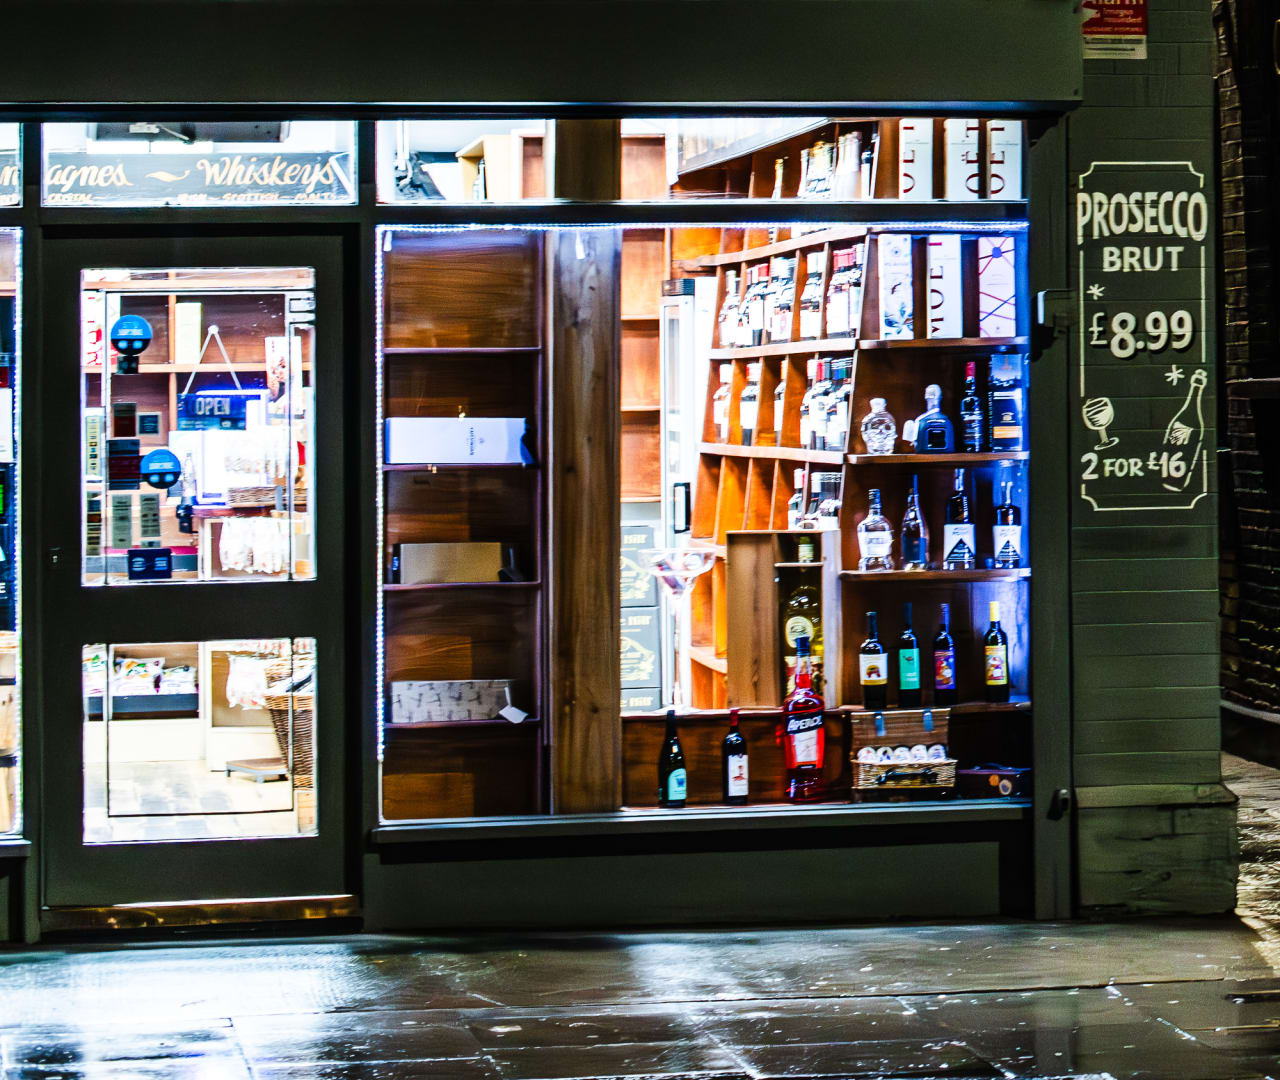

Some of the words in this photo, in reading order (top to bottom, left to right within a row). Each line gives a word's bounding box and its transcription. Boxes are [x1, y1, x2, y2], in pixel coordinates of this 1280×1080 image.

[196, 155, 336, 195] Whiskeys
[1077, 191, 1208, 245] PROSECCO
[1102, 246, 1185, 272] BRUT
[1089, 310, 1194, 359] £8.99
[195, 397, 231, 416] OPEN
[1081, 452, 1099, 480] 2
[1103, 458, 1145, 478] FOR
[1147, 451, 1187, 478] £16
[787, 715, 823, 732] APEROL
